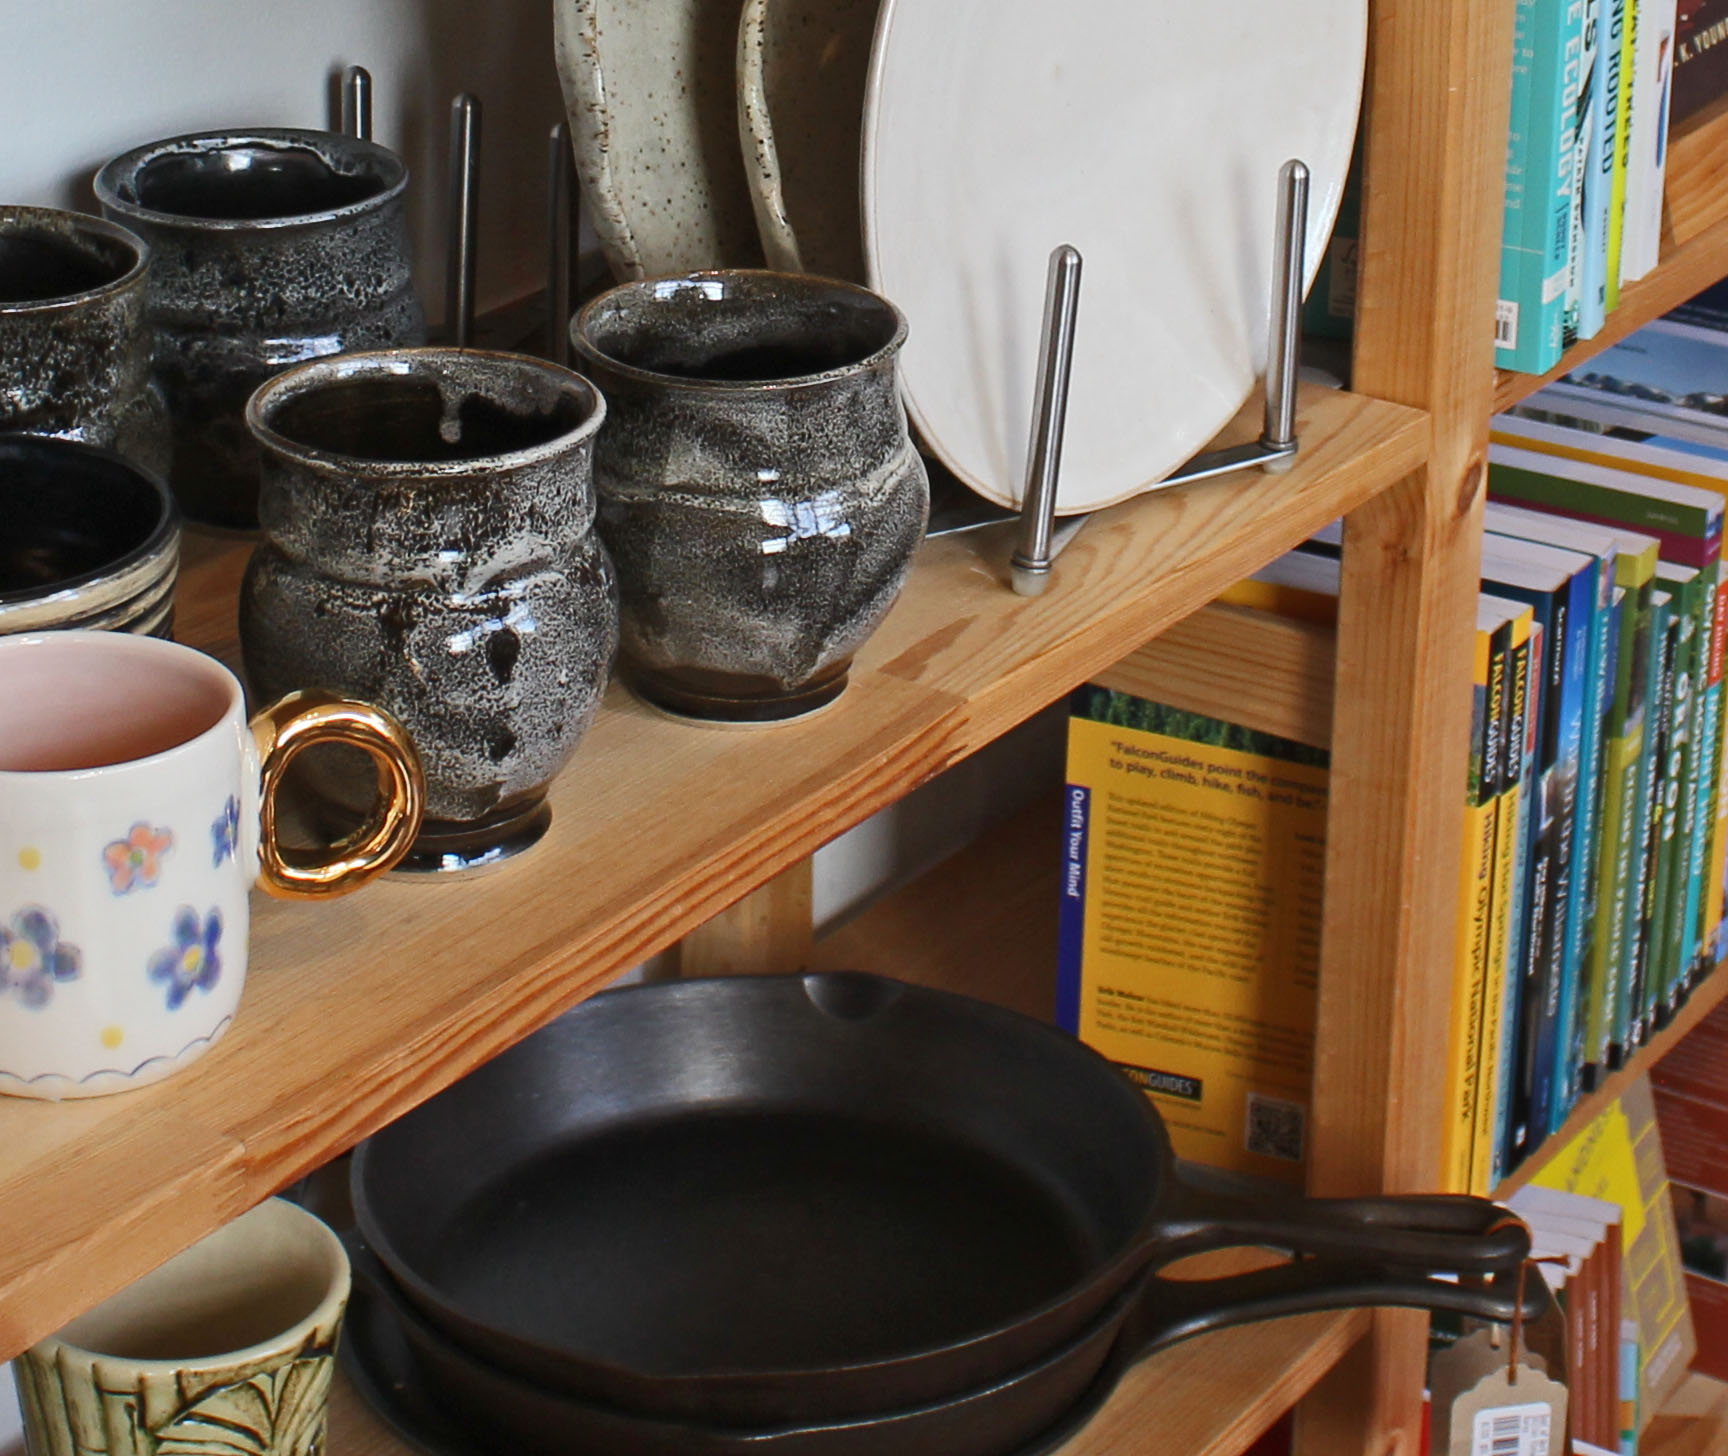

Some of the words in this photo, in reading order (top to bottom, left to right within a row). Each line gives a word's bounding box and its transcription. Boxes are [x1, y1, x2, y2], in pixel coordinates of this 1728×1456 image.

[1071, 789, 1085, 828] Outfit
[1069, 832, 1083, 860] Your
[1067, 862, 1080, 897] Mind
